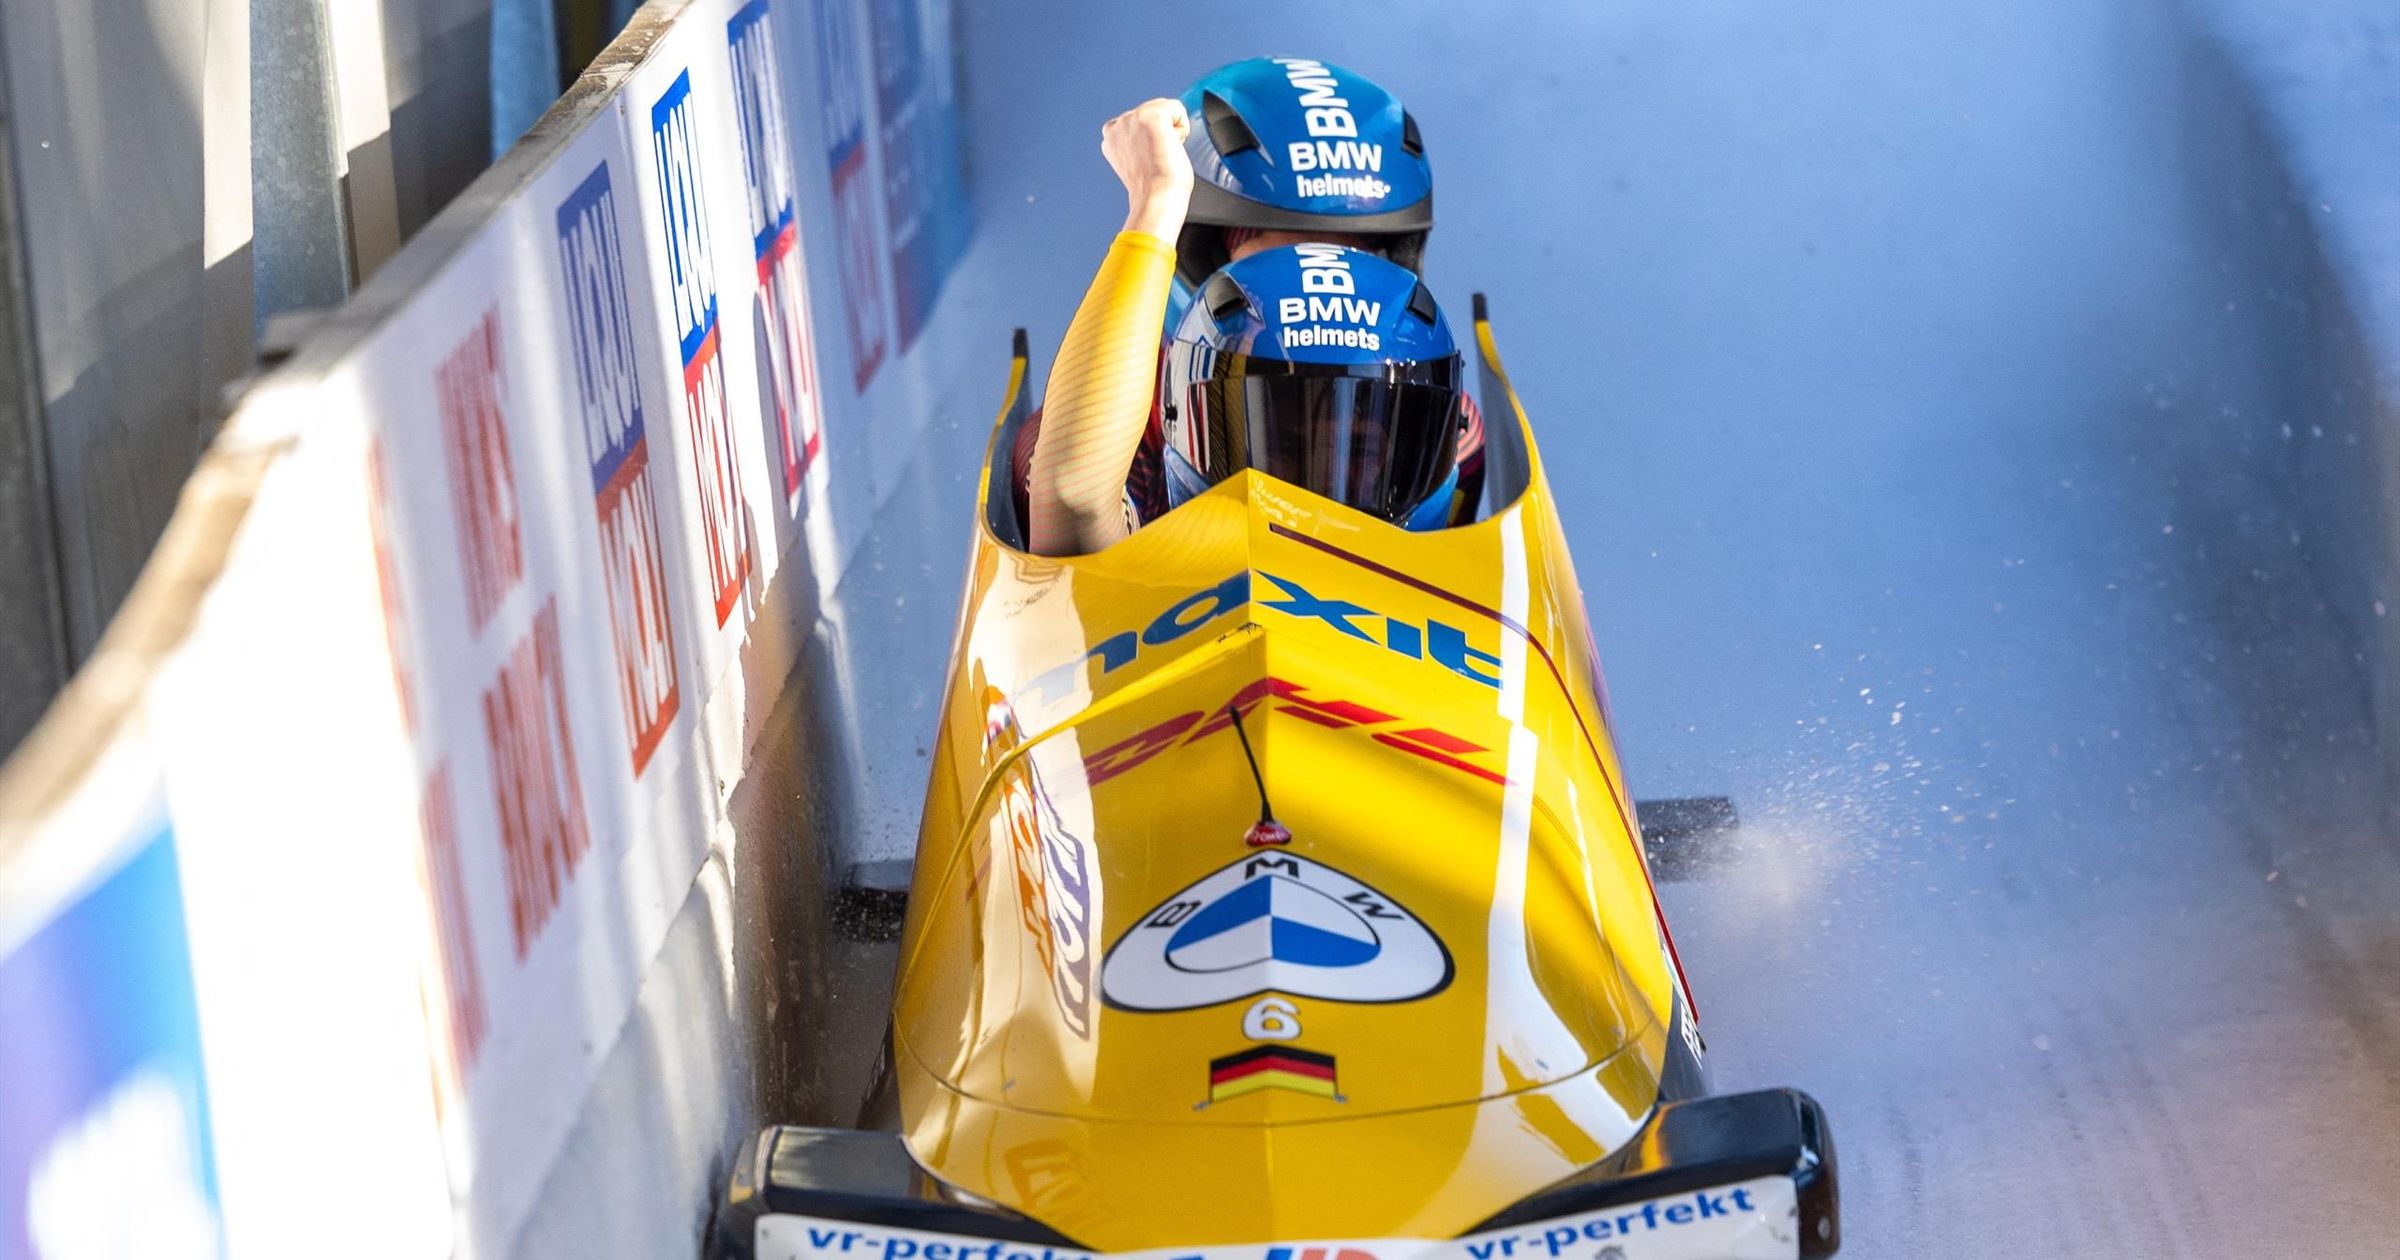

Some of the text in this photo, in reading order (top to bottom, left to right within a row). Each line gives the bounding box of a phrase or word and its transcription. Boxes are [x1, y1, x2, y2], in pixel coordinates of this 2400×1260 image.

[1288, 140, 1382, 172] BMW
[561, 189, 640, 466] LIQUI
[1279, 297, 1380, 326] BMW
[1284, 325, 1380, 351] helmets
[600, 463, 675, 753] MOLY
[1012, 567, 1504, 706] maxit
[1083, 676, 1518, 788] DHL
[1144, 857, 1405, 929] BMW
[1241, 997, 1302, 1041] 6
[808, 1227, 1092, 1260] vr-perf
[1465, 1188, 1755, 1260] vr-perfekt
